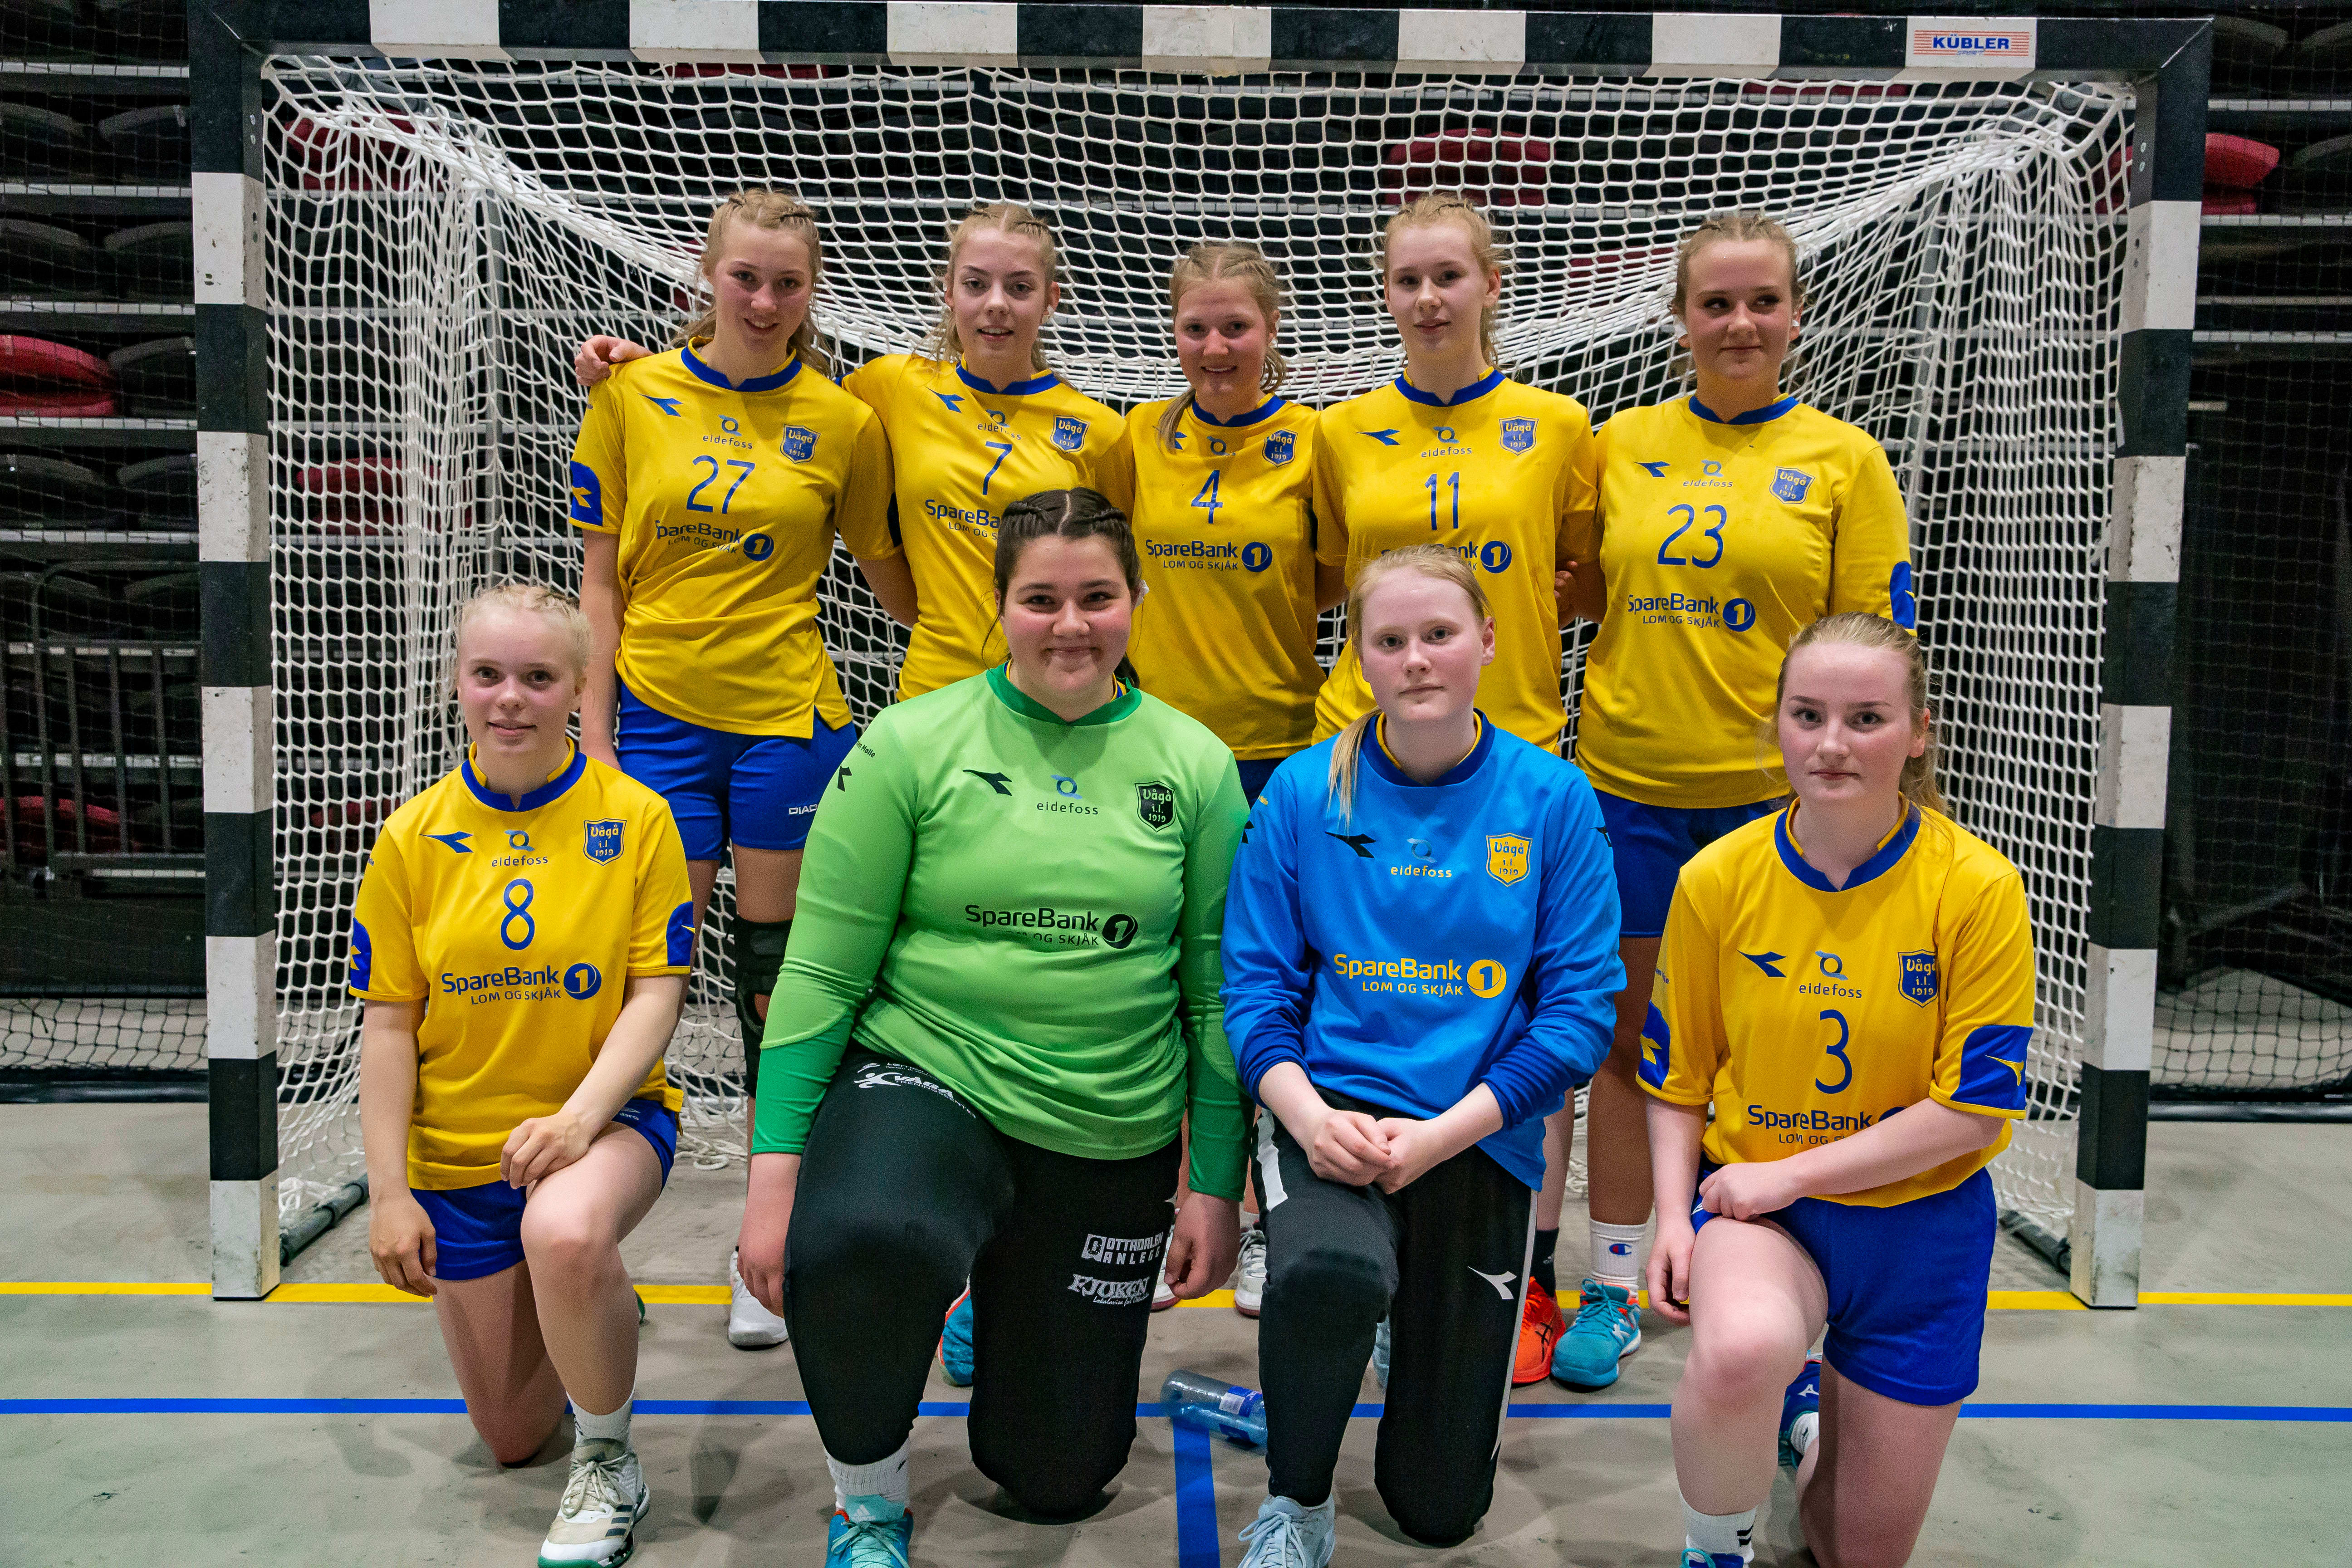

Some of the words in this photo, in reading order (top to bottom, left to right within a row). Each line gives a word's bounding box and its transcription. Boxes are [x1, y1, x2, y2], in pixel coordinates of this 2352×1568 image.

[1933, 34, 2009, 49] KÜBLER
[703, 434, 753, 449] eidefoss
[1059, 439, 1075, 447] 1919
[790, 449, 805, 457] 1919
[1421, 446, 1472, 458] eidefoss
[982, 441, 1012, 495] 7
[686, 456, 755, 514] 27
[1683, 479, 1733, 487] eidefoss
[1191, 470, 1223, 524] 4
[1424, 472, 1459, 530] 11
[1779, 489, 1796, 499] 1919
[925, 499, 1000, 529] SpareBa
[949, 522, 970, 533] LOM
[973, 528, 988, 537] OG
[1657, 504, 1727, 568] 23
[668, 535, 690, 545] LOM
[694, 537, 708, 547] OG
[1146, 539, 1238, 559] SpareBank
[1207, 560, 1238, 571] SKJÅK
[1628, 593, 1720, 614] SpareBank
[1643, 615, 1666, 623] LOM
[1669, 615, 1682, 623] OG
[1687, 616, 1720, 628] SKJÅK
[789, 804, 817, 814] DIAD
[1037, 801, 1098, 815] eidefoss
[1149, 813, 1166, 822] 1919
[492, 855, 548, 866] eidefoss
[1391, 865, 1451, 877] eidefoss
[1499, 867, 1519, 876] 1919
[500, 879, 534, 950] 8
[965, 904, 1099, 931] SpareBank
[1033, 933, 1053, 943] OG
[1058, 933, 1099, 946] SKJÅK
[1334, 954, 1462, 980] SpareBank
[441, 965, 560, 995] SpareBank
[471, 991, 500, 1004] LOM
[504, 990, 521, 1000] OG
[524, 987, 561, 1001] SKJÅK
[1362, 981, 1392, 992] LOM
[1398, 983, 1416, 993] OG
[1422, 983, 1463, 997] SKJÅK
[1799, 982, 1862, 998] eidefoss
[1912, 987, 1934, 995] 1919
[1815, 1009, 1852, 1094] 3
[1748, 1104, 1873, 1131] SpareBank
[1779, 1133, 1803, 1144] LOM
[1808, 1135, 1828, 1145] OG
[1106, 1232, 1163, 1251] OTTADALEN
[1102, 1246, 1160, 1264] ANLEGG
